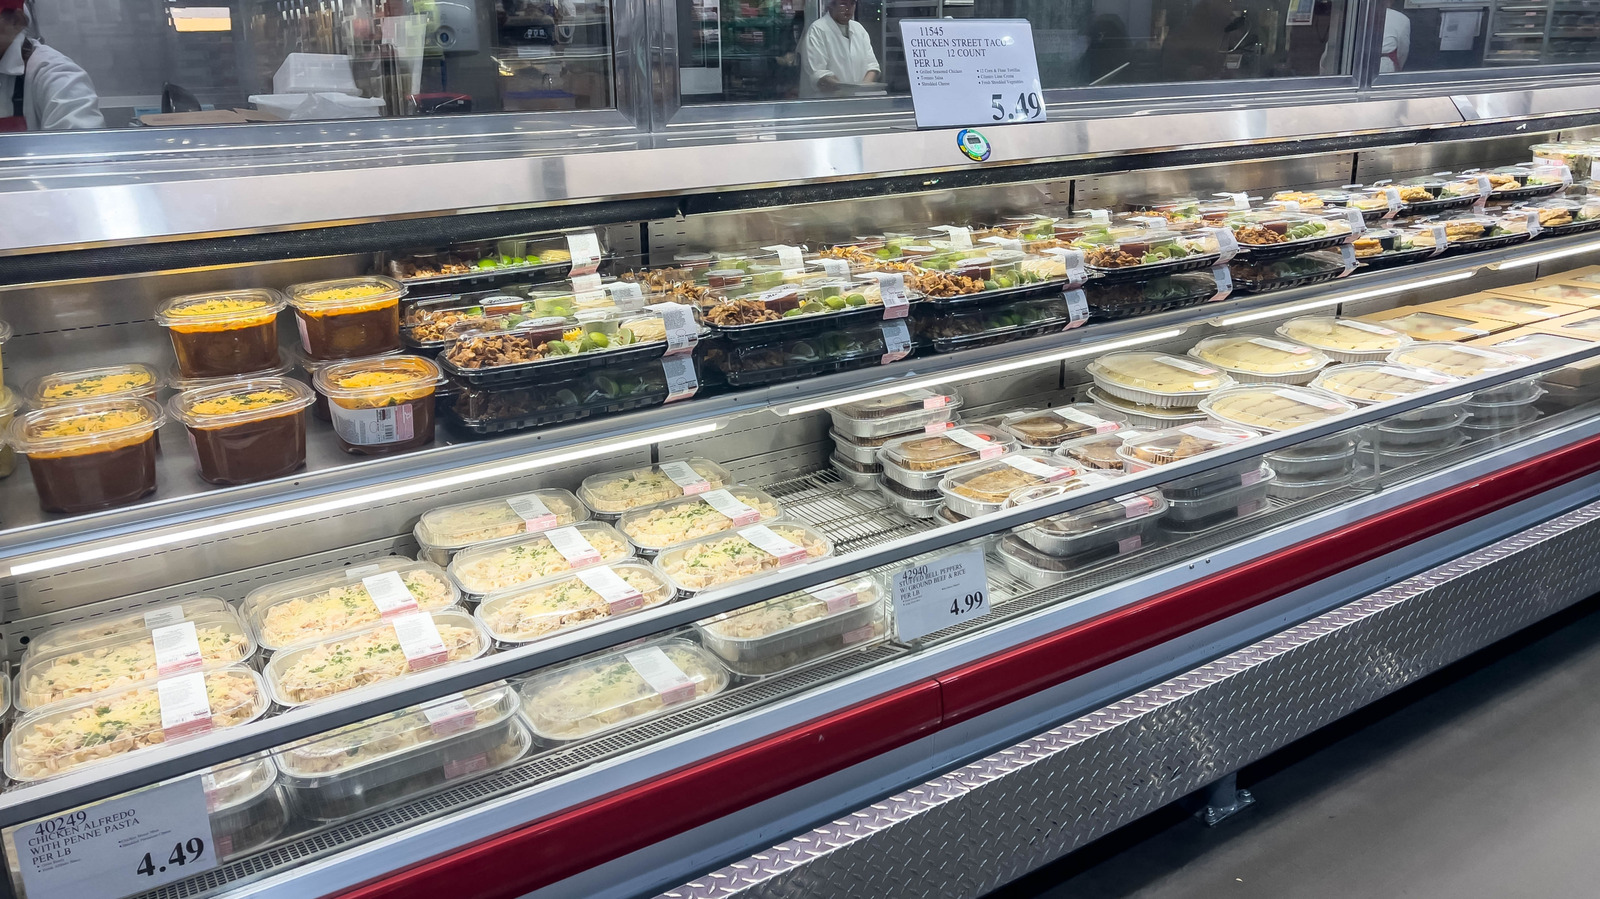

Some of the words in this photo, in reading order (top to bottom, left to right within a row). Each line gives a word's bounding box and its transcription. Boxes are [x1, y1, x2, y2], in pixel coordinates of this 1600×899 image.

[920, 26, 944, 36] 11545
[910, 38, 950, 48] CHICKEN
[952, 38, 982, 47] STREET
[912, 49, 927, 58] KIT
[946, 49, 956, 57] 12
[957, 48, 986, 57] COUNT
[914, 59, 931, 68] PER
[932, 58, 944, 67] LB
[991, 92, 1041, 121] 5.49
[899, 575, 925, 588] STUFFED
[925, 570, 939, 579] BELL
[940, 564, 963, 575] PEPPERS
[902, 565, 928, 580] 42940
[908, 579, 933, 591] GROUND
[933, 575, 947, 584] BEEF
[954, 569, 966, 577] RICE
[900, 592, 912, 601] PER
[912, 590, 921, 598] LB
[950, 591, 983, 616] 4.99
[28, 825, 80, 847] CHICKEN
[83, 808, 136, 831] ALFREDO
[34, 810, 87, 836] 40249
[30, 842, 61, 856] WITH
[64, 830, 101, 847] PENNE
[104, 818, 140, 834] PASTA
[32, 853, 54, 865] PER
[57, 847, 72, 860] LB
[136, 837, 204, 877] 4.49
